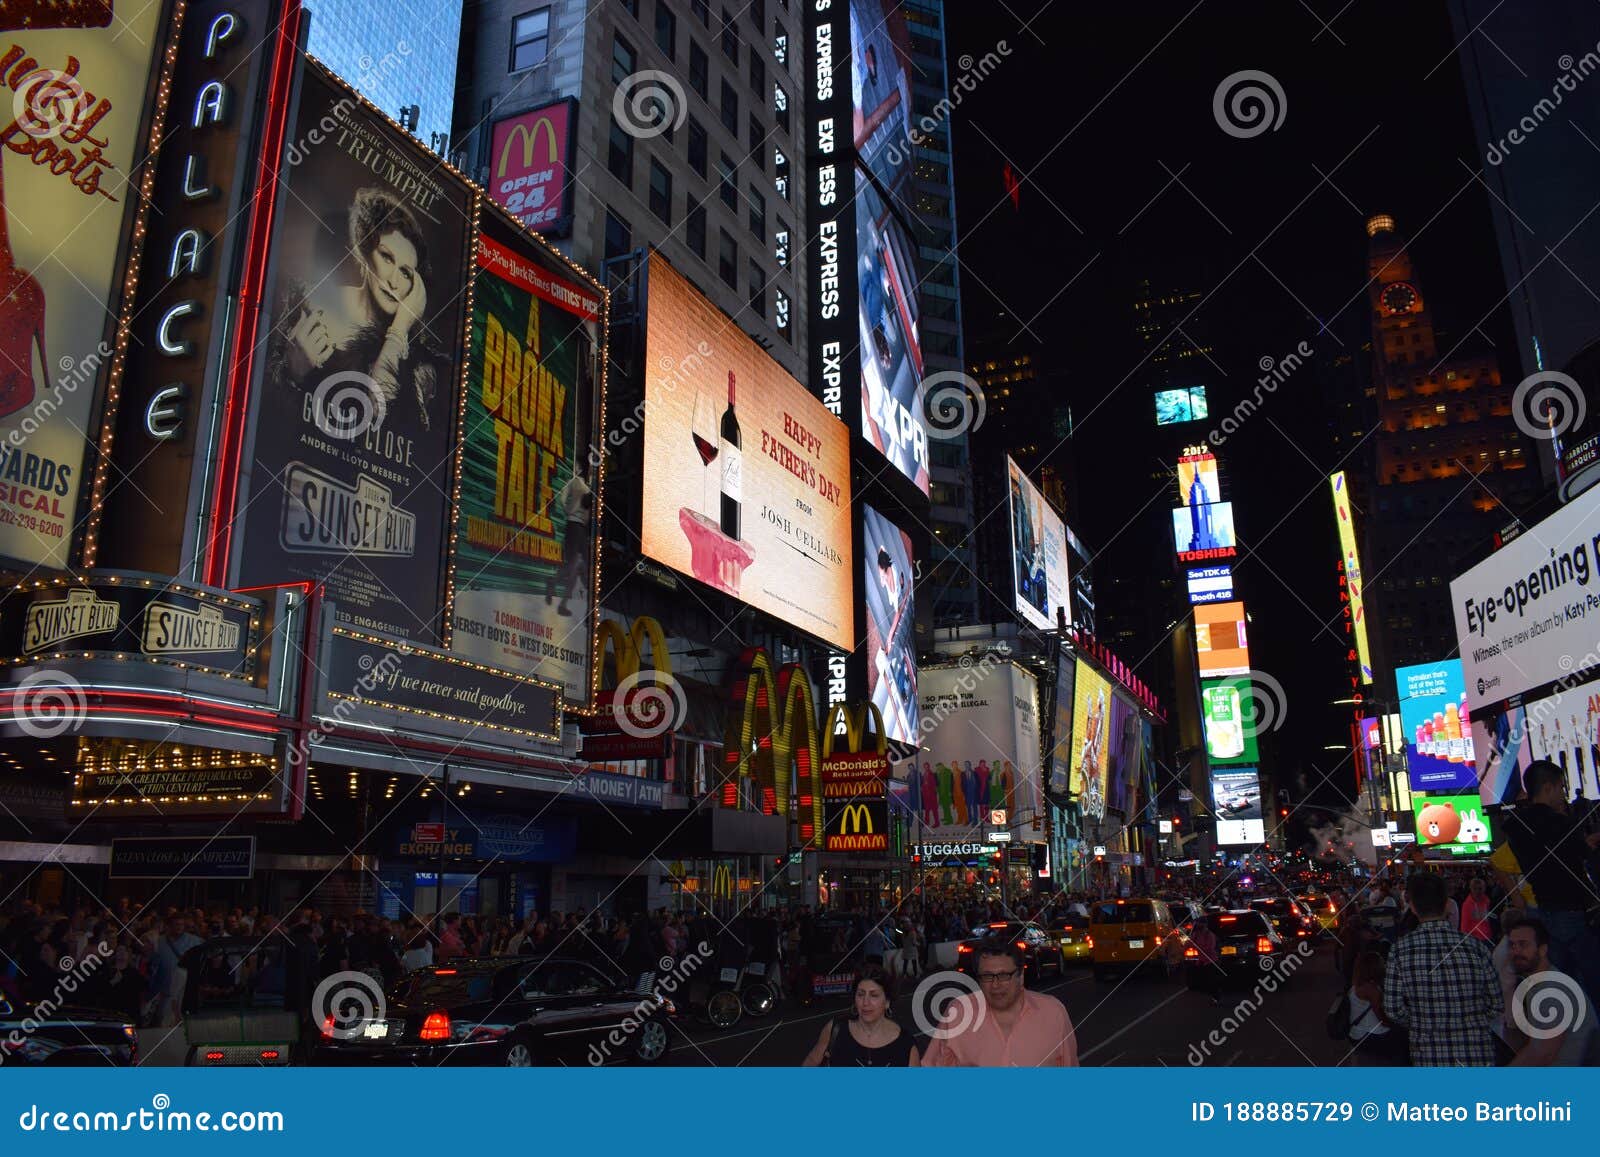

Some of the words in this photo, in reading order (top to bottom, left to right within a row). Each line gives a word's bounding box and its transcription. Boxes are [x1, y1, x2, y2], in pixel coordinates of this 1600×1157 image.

[816, 23, 833, 101] EXPRESS
[500, 169, 553, 194] OPEN
[506, 185, 546, 211] 24
[147, 12, 237, 437] PALACE
[516, 207, 559, 227] URS
[820, 220, 840, 320] EXPRESS
[525, 293, 541, 355] A
[582, 296, 599, 314] PICK
[481, 311, 566, 459] BRONX
[300, 434, 338, 457] ANDREW
[341, 451, 368, 470] LLOYD
[365, 421, 415, 468] CLOSE
[783, 412, 822, 460] HAPPY
[1567, 437, 1600, 460] ARRIOTT
[493, 417, 558, 534] TALE
[761, 430, 817, 490] FATHER'S
[818, 472, 841, 508] DAY
[299, 481, 382, 549] SUNSET
[761, 504, 792, 535] JOSH
[795, 521, 843, 567] CELLARS
[1177, 546, 1237, 562] TOSHIBA
[1191, 593, 1215, 602] Booth
[1336, 560, 1352, 634] ERNST
[1465, 543, 1590, 637] Eye-opening
[32, 604, 86, 646] SUNSET
[156, 610, 216, 649] SUNSET
[354, 615, 410, 638] ENGAGEMENT
[453, 615, 486, 636] JERSEY
[487, 627, 510, 646] BOYS
[519, 634, 542, 654] WEST
[501, 611, 545, 636] COMBINATION
[1472, 642, 1503, 664] Witness,
[1502, 636, 1514, 650] the
[1513, 627, 1529, 645] new
[1530, 617, 1554, 638] album
[1554, 611, 1564, 629] by
[1564, 602, 1587, 621] Katy
[1347, 650, 1358, 661] &
[386, 668, 403, 691] if
[401, 675, 419, 690] we
[420, 679, 454, 699] never
[453, 687, 480, 705] said
[598, 698, 666, 717] cDonald's
[822, 758, 887, 771] McDonald's
[832, 769, 876, 778] Restaurant
[589, 776, 632, 799] MONEY
[639, 786, 662, 801] ATM
